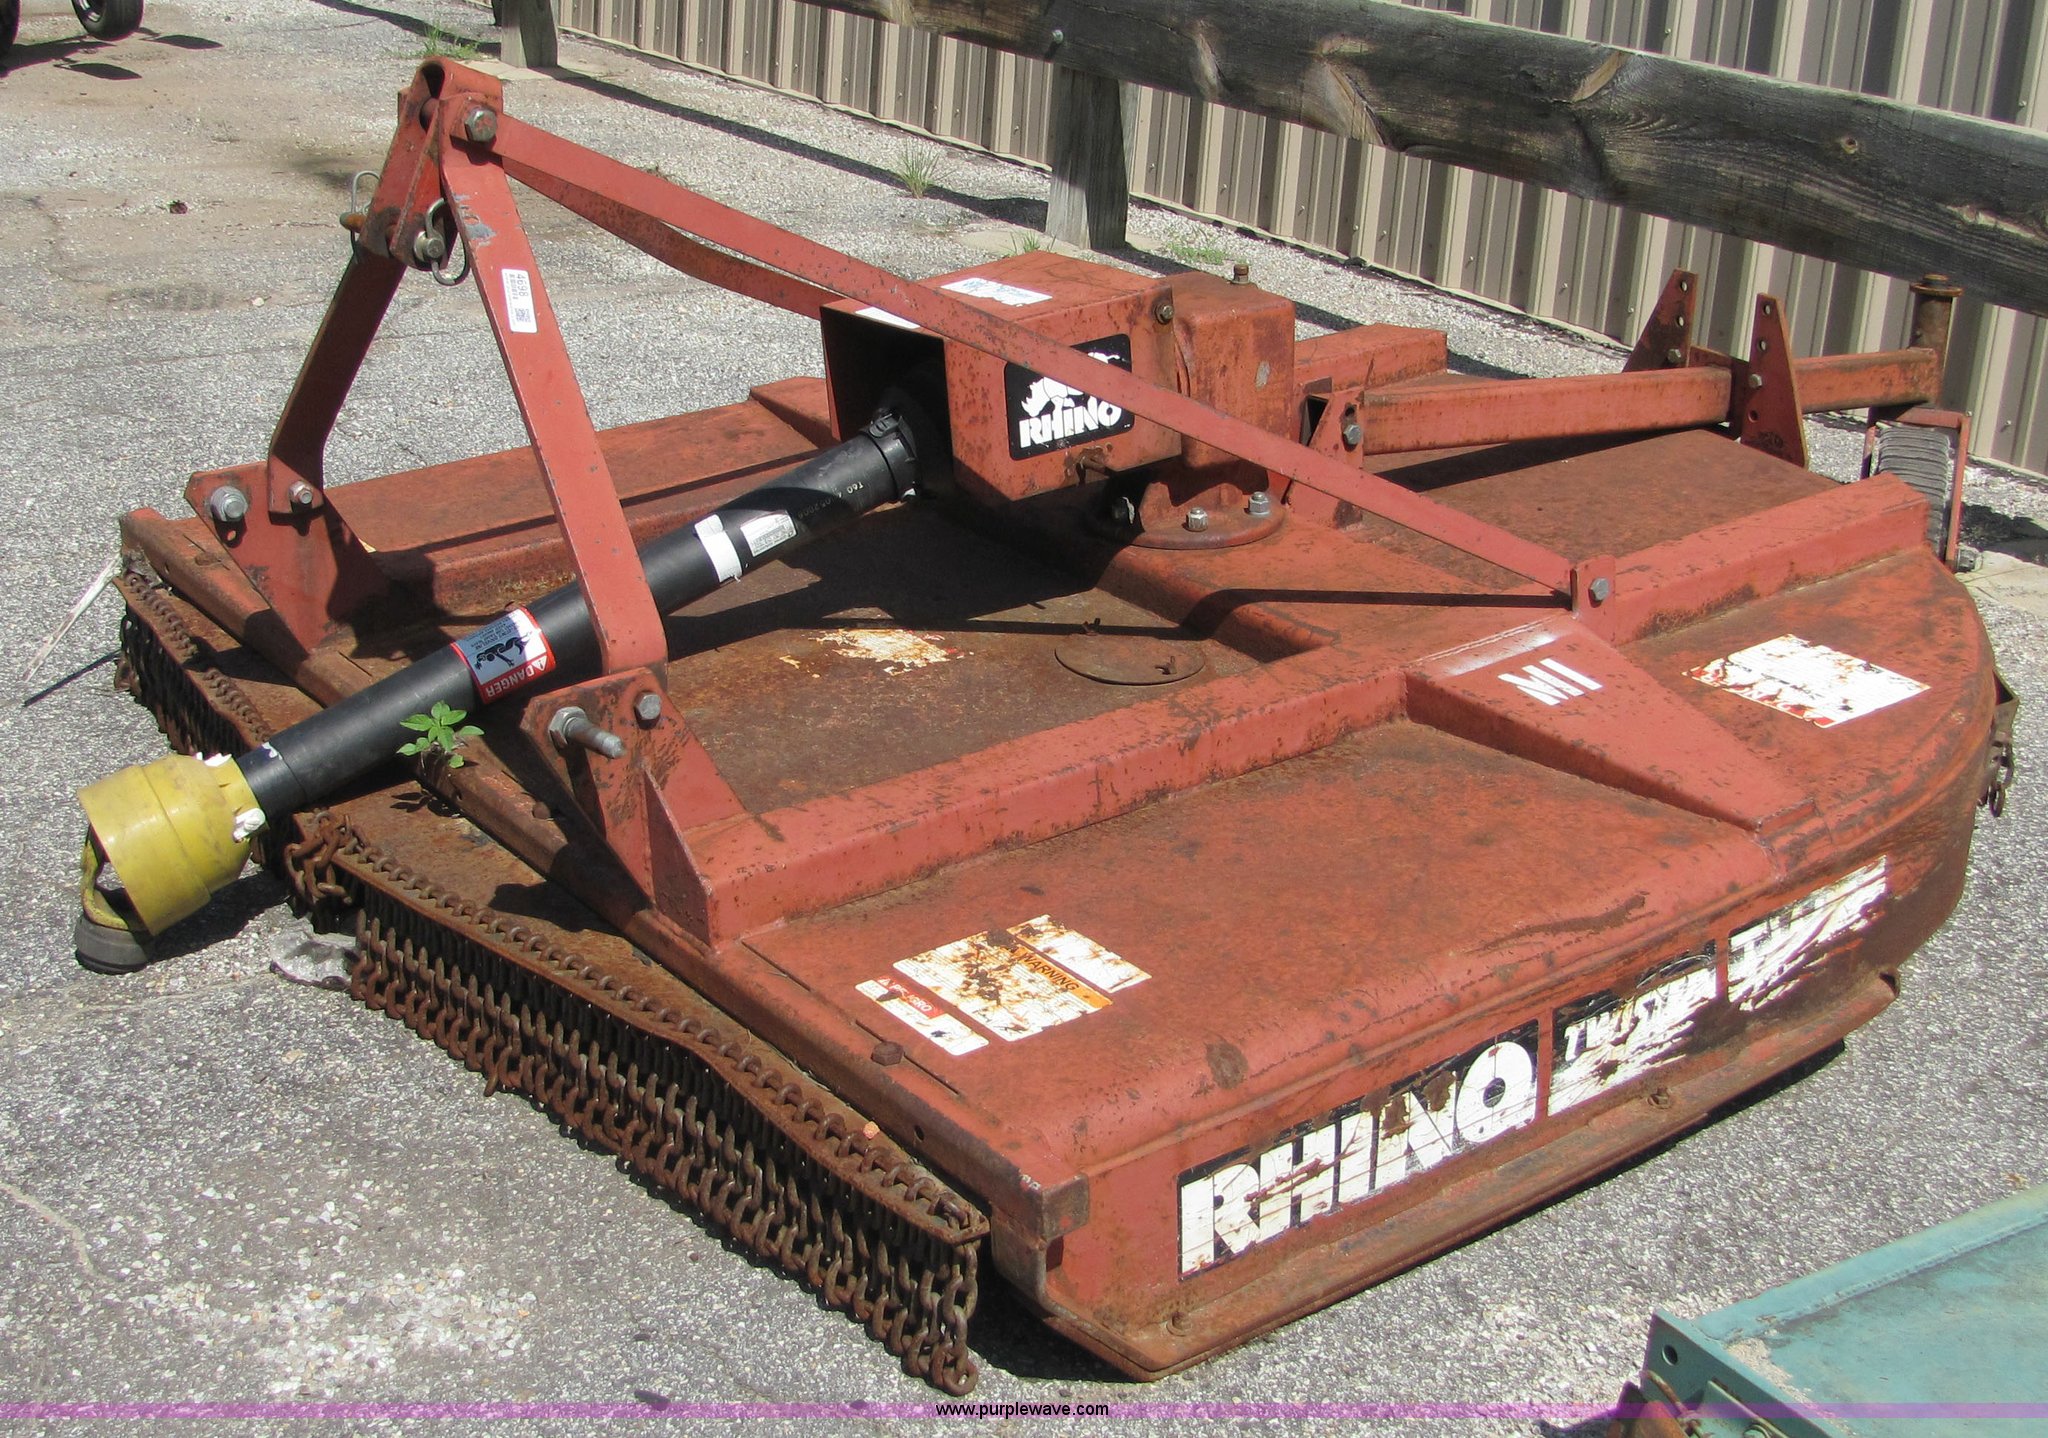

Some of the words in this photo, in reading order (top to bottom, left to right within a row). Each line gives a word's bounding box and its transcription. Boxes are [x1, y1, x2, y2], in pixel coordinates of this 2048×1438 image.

[516, 273, 529, 297] 4698
[1019, 396, 1122, 449] RHINO
[485, 664, 535, 697] DANGER
[1020, 953, 1080, 992] WARNING
[888, 983, 934, 1013] PEIGRO
[1181, 1041, 1536, 1275] RHINO
